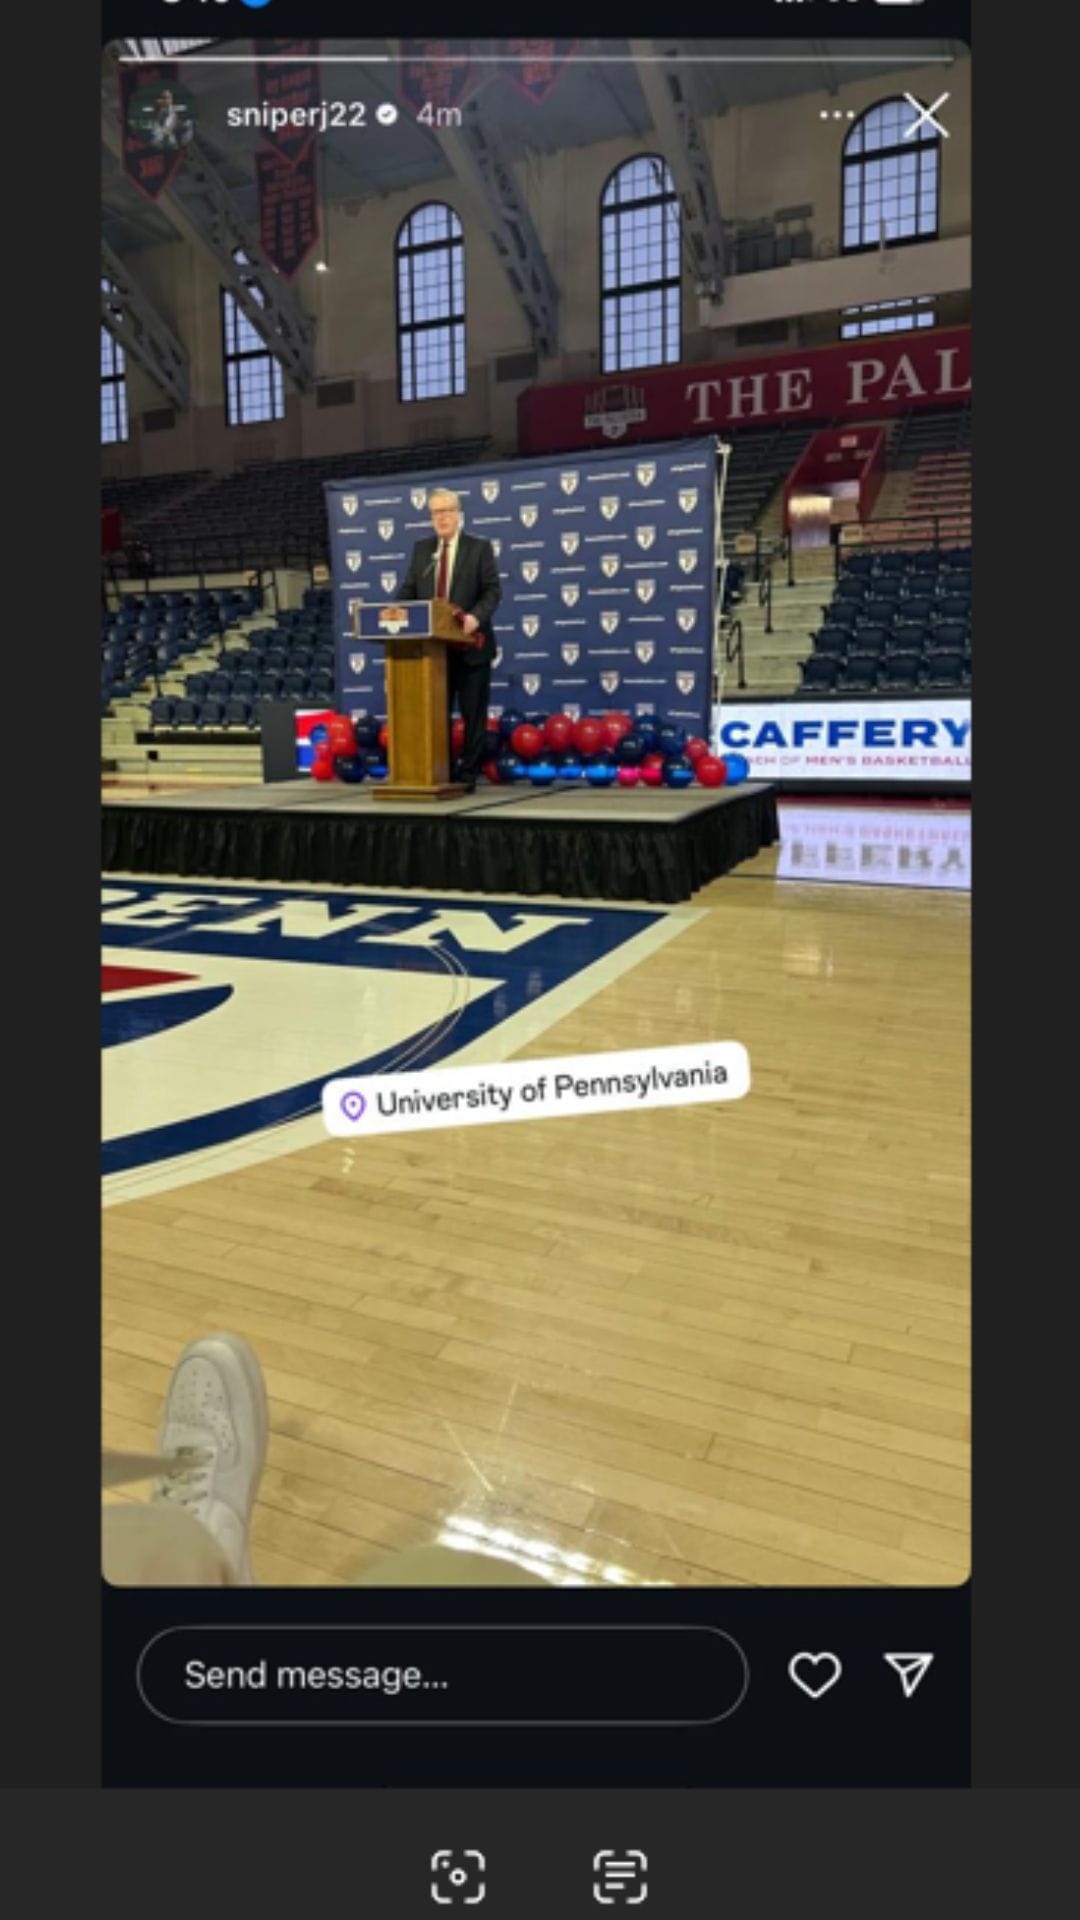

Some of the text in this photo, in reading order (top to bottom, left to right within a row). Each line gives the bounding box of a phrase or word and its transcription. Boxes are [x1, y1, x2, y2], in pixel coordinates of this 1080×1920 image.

[685, 347, 971, 424] THE PAL
[720, 718, 971, 748] CAFFERY
[806, 755, 857, 766] MEN'S
